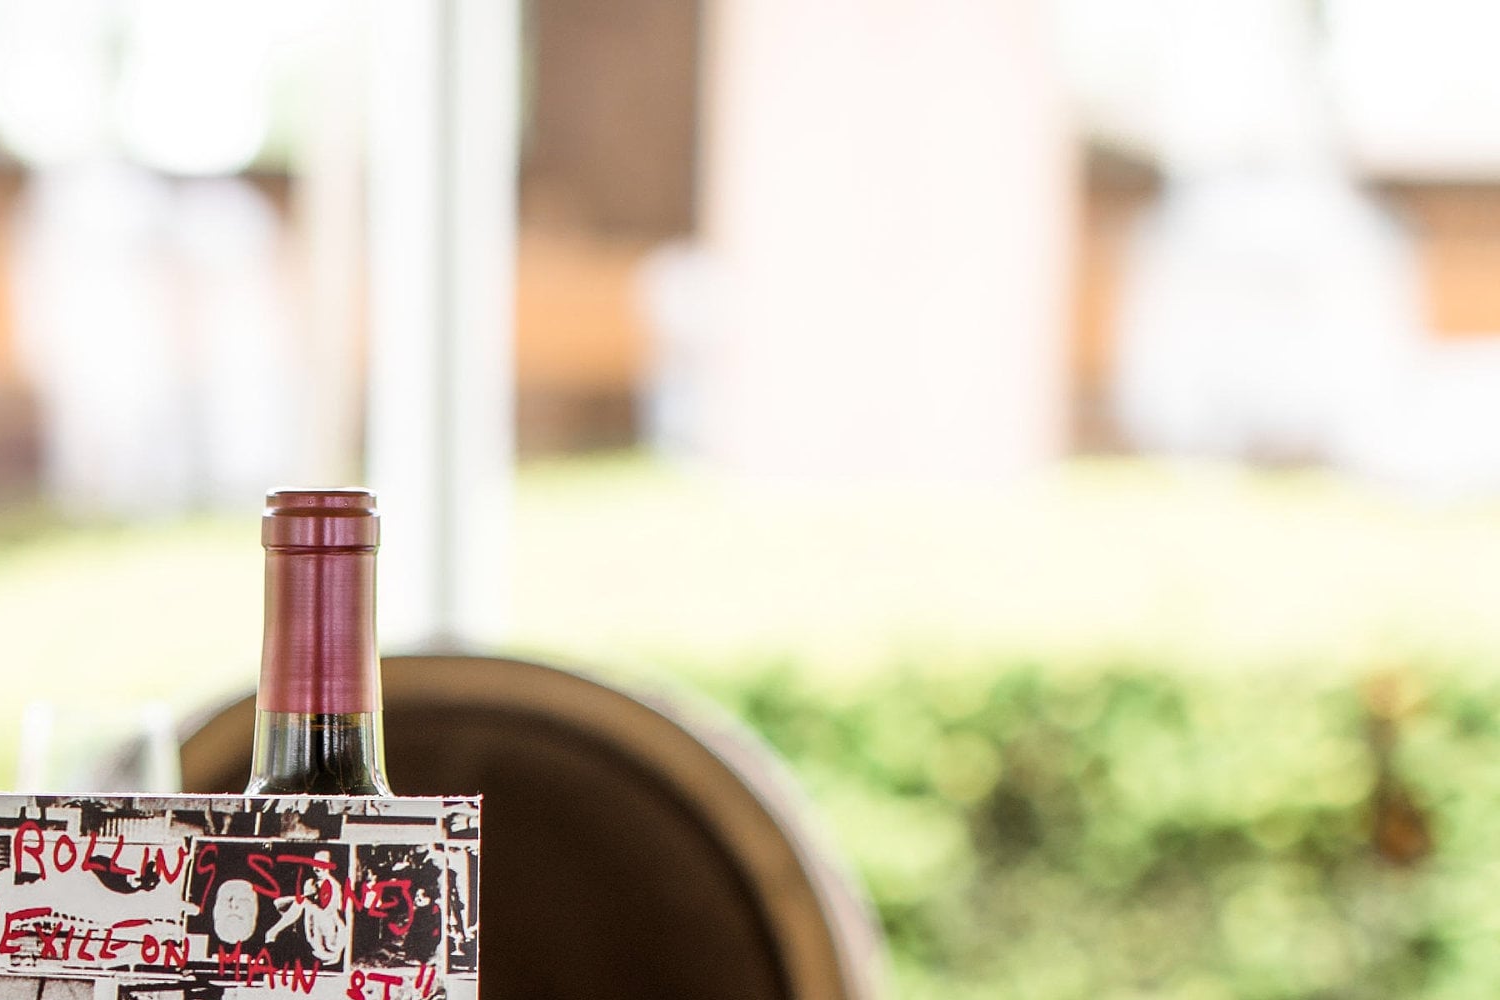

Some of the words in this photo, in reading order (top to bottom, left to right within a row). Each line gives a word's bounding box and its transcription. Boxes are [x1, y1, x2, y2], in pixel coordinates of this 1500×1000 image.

[14, 820, 218, 913] ROLLING
[140, 934, 190, 969] ON
[217, 939, 320, 995] MAIN
